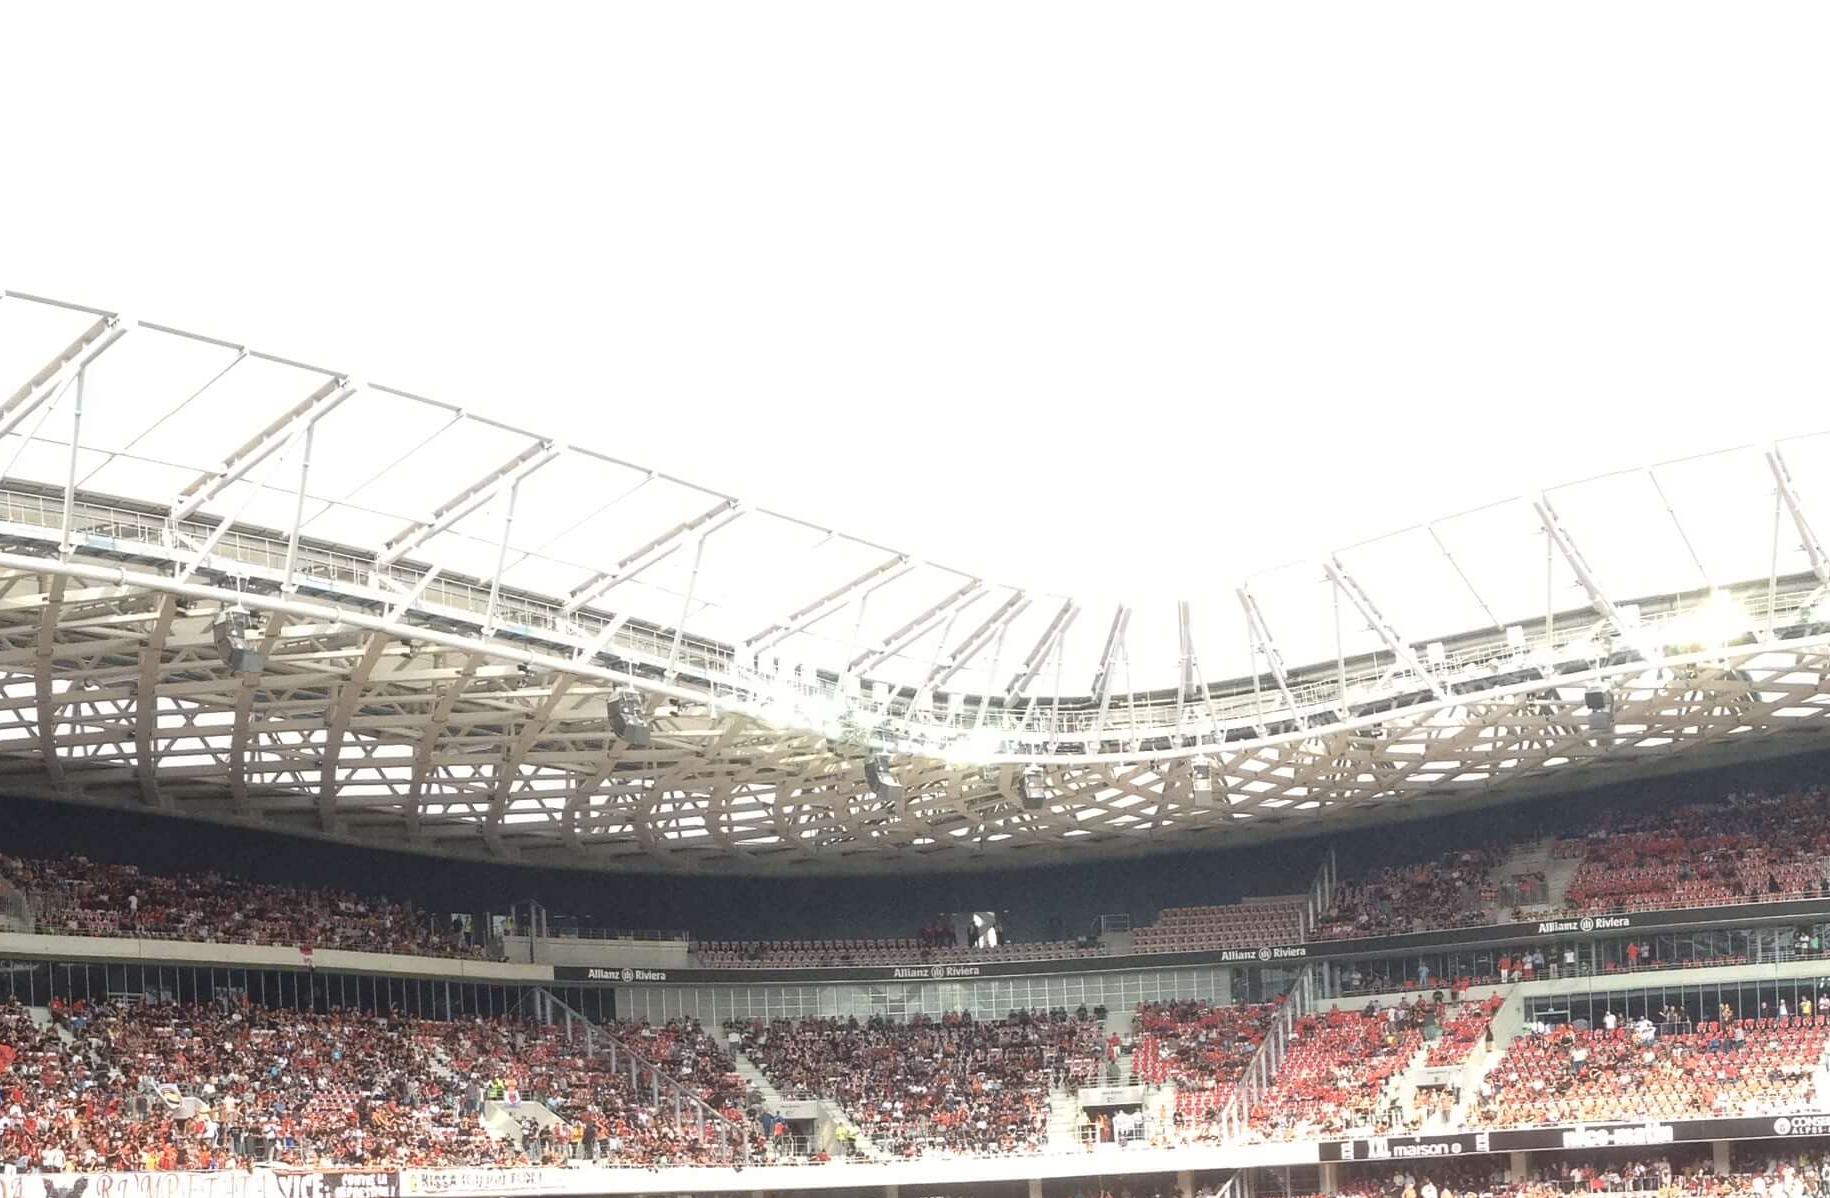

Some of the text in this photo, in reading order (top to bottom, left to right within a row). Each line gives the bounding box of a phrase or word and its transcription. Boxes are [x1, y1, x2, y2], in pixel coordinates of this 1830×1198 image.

[1595, 916, 1630, 930] Riviera
[1221, 945, 1306, 961] Allianz Riviera
[588, 968, 666, 981] Allianz Riviera
[894, 966, 980, 978] Allianz Riviera
